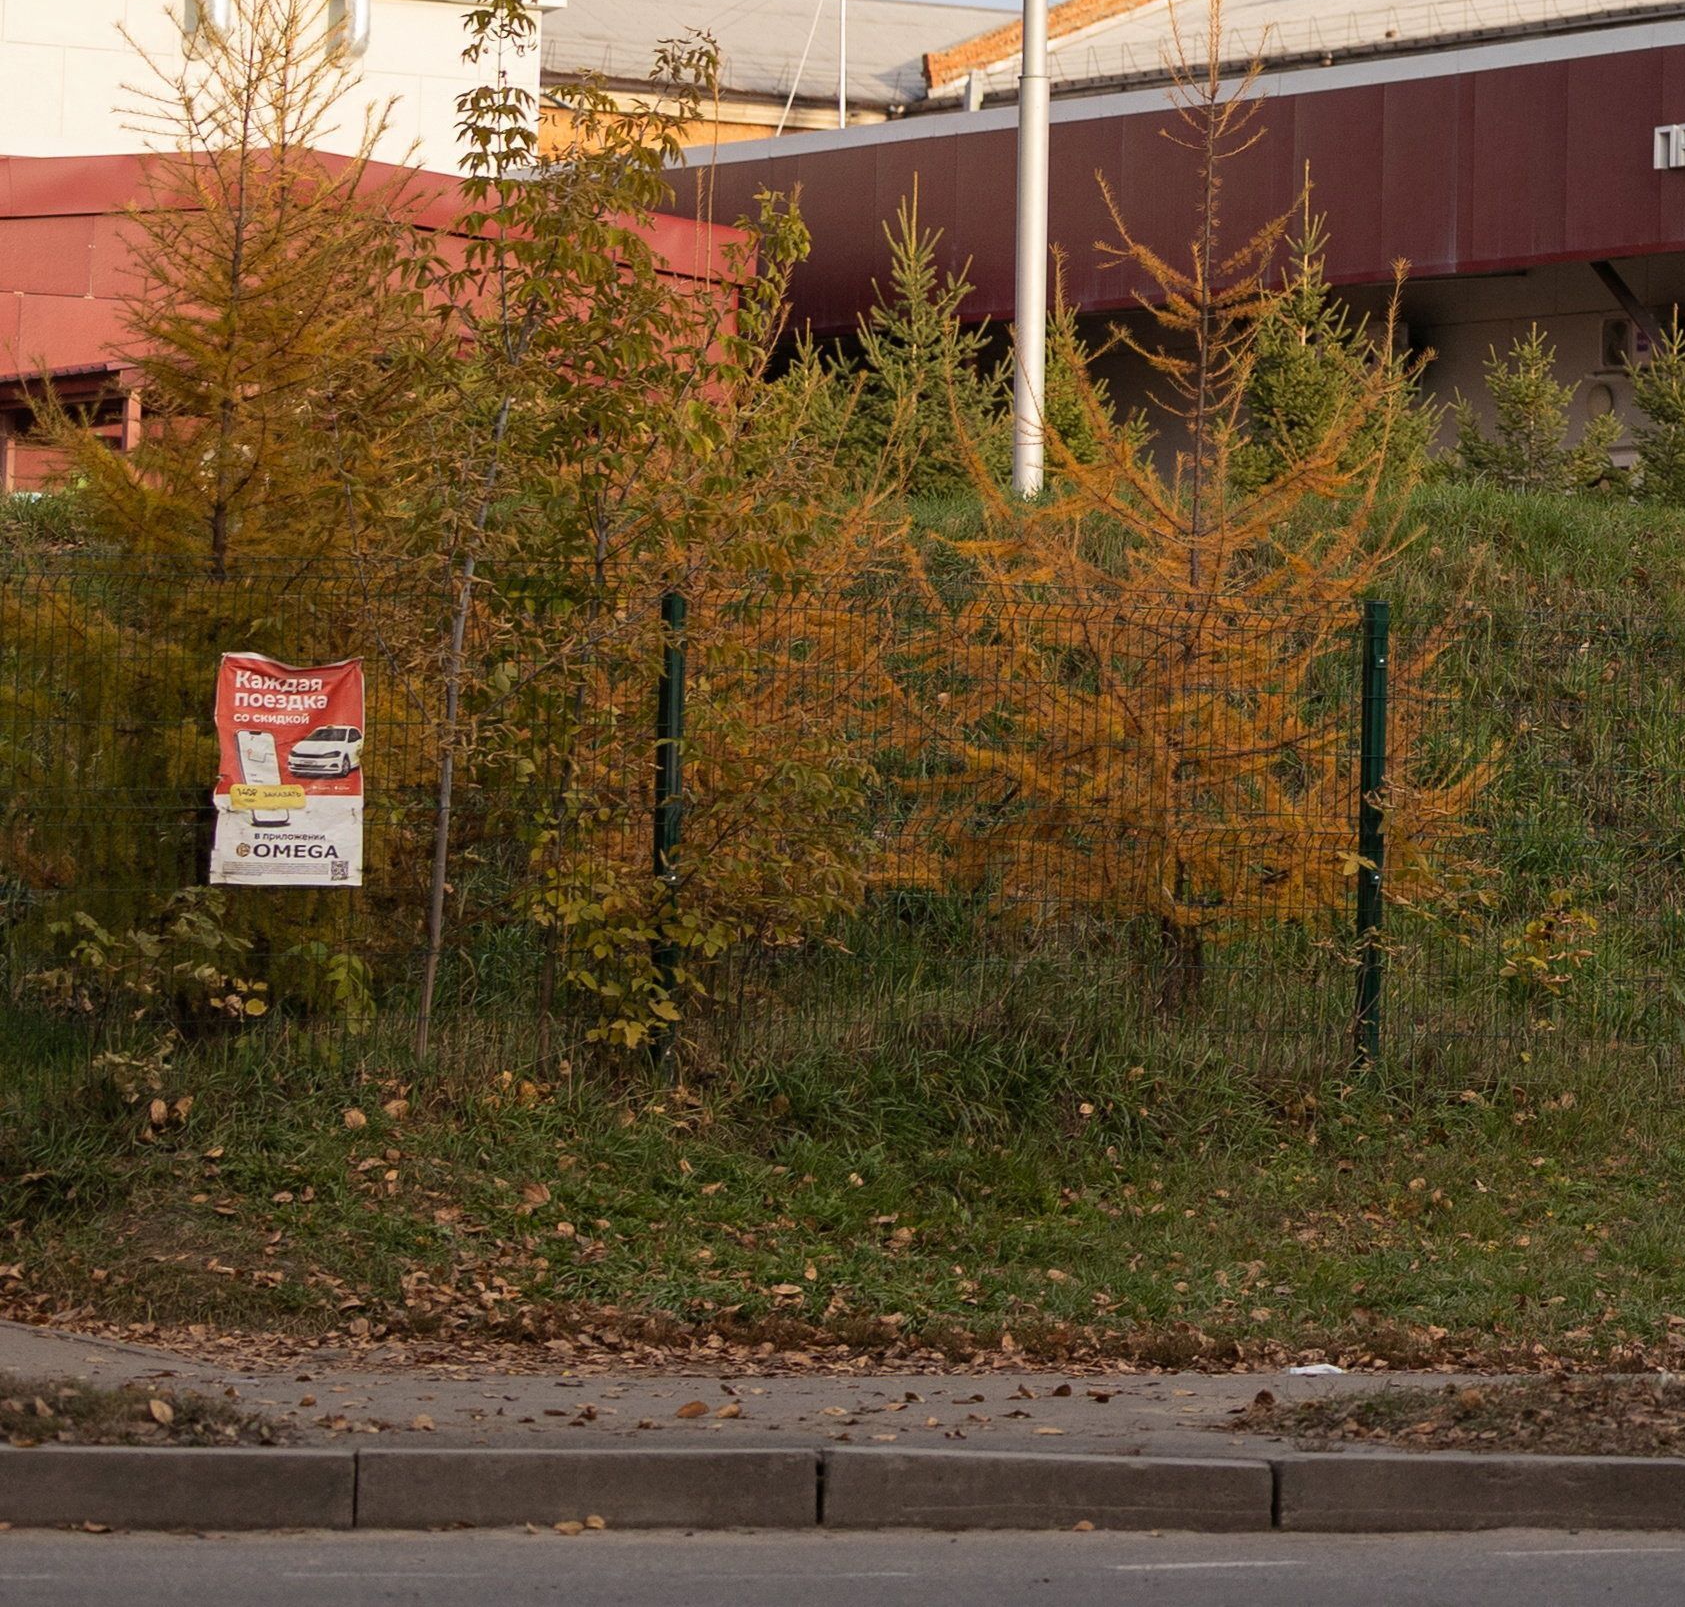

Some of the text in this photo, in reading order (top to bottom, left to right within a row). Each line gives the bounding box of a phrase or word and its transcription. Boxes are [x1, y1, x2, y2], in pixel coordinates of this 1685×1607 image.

[235, 670, 323, 693] Каждая
[234, 692, 328, 711] поездка
[233, 712, 310, 725] со скидкой
[262, 832, 326, 842] приложении
[253, 843, 339, 859] OMEGA
